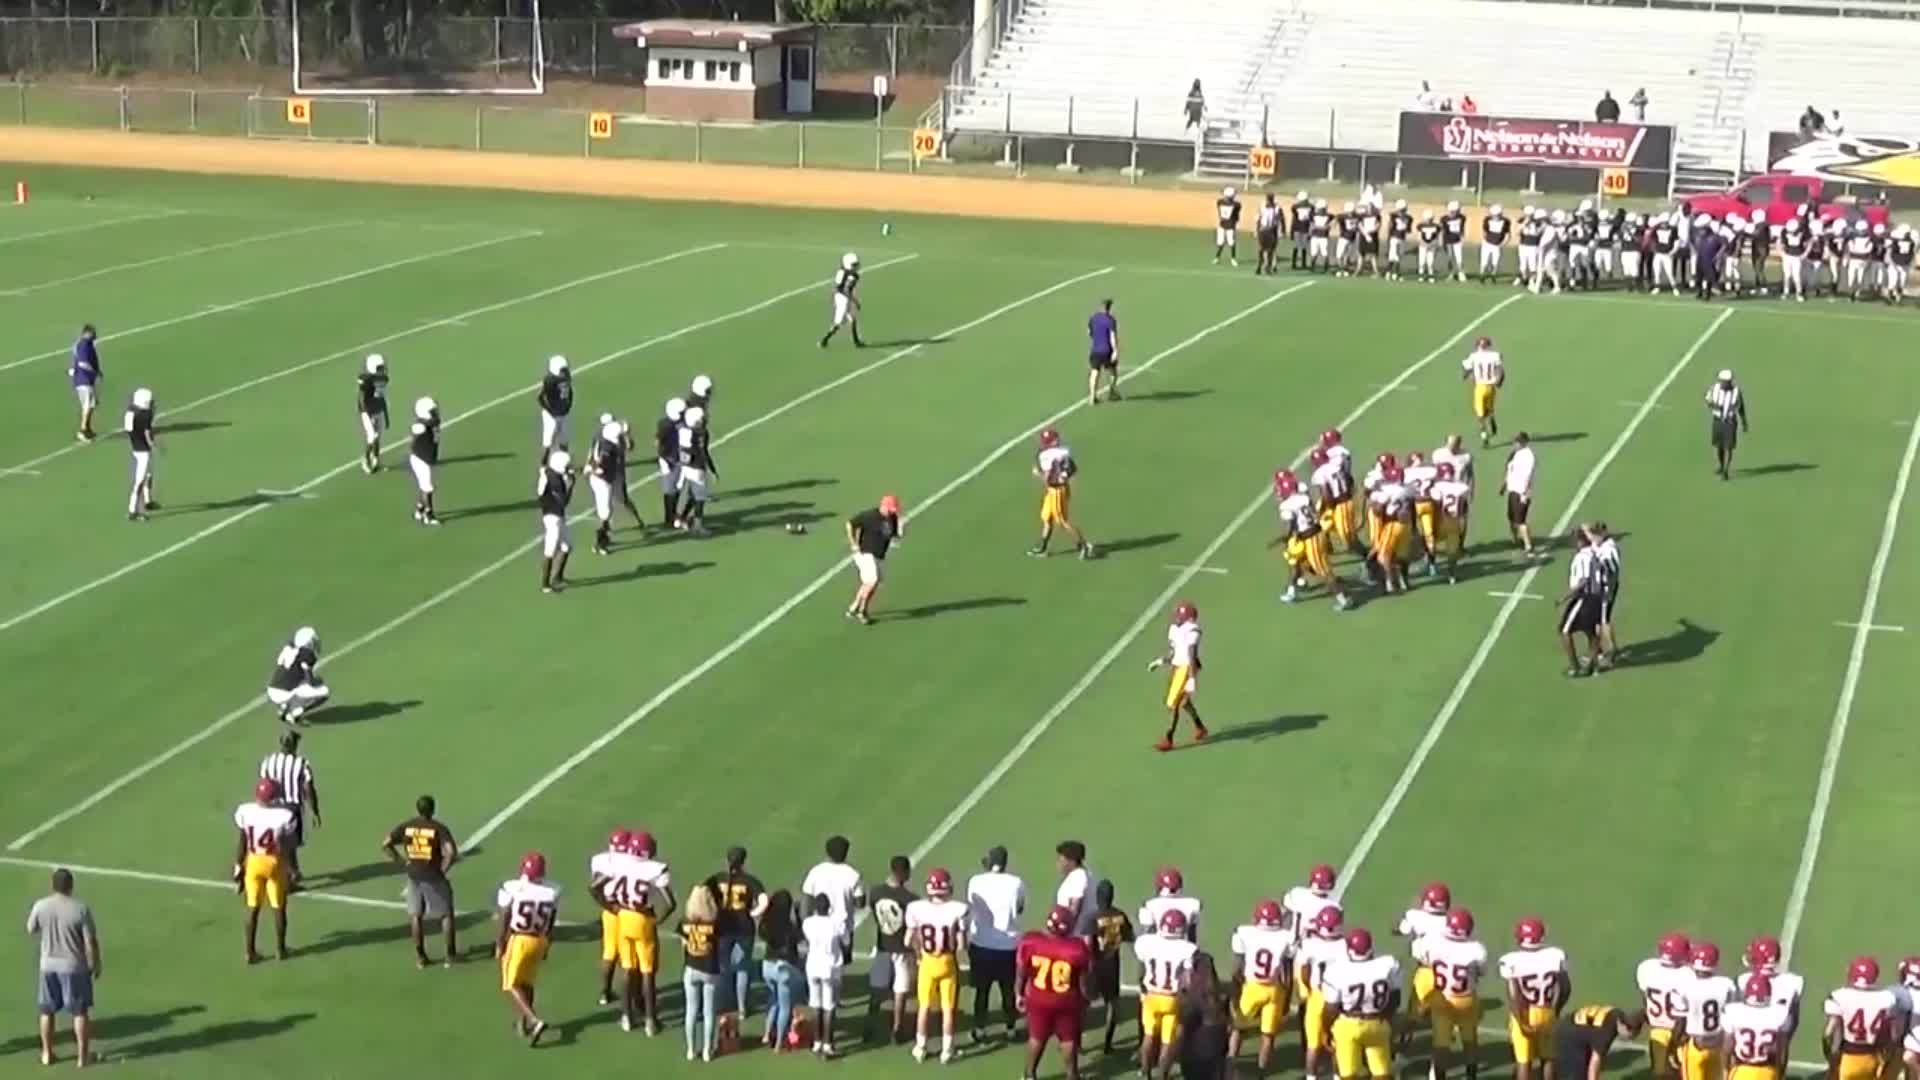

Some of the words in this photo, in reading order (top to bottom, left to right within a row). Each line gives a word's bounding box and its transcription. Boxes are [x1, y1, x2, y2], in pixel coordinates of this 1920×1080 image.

[593, 119, 608, 133] 10
[915, 135, 934, 151] 20
[1252, 153, 1273, 169] 30
[1604, 174, 1625, 189] 40
[248, 825, 279, 855] 14
[610, 875, 649, 911] 45
[516, 900, 555, 932] 55
[920, 923, 951, 953] 81
[1148, 959, 1173, 990] 11
[1253, 948, 1273, 979] 9
[1432, 959, 1470, 992] 65
[1348, 979, 1390, 1012] 78
[1521, 970, 1558, 1004] 52
[1702, 999, 1719, 1031] 8
[1847, 1007, 1892, 1042] 44
[1738, 1028, 1777, 1061] 32
